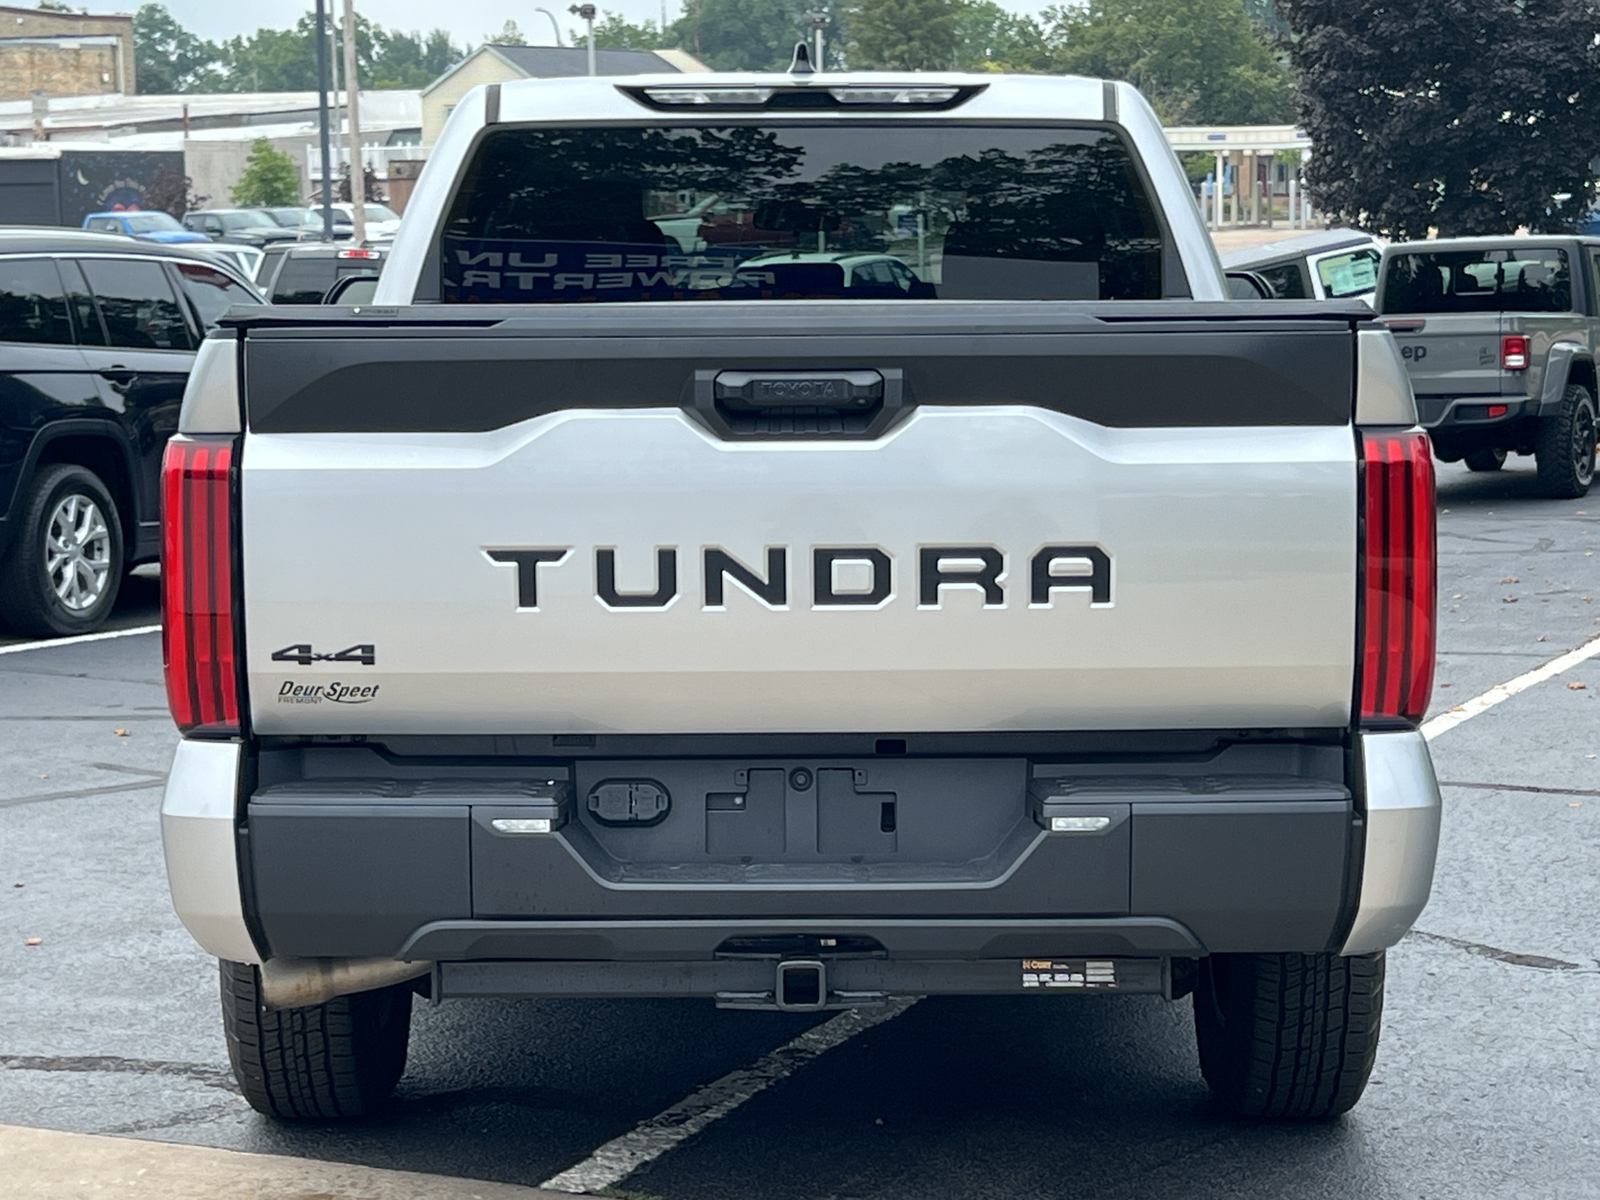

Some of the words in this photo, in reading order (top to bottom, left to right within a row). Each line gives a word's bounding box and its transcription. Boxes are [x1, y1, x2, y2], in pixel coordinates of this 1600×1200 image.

[1401, 345, 1427, 361] ep
[760, 381, 838, 398] TOYOTA
[480, 543, 1116, 612] TUNDRA
[271, 644, 375, 665] 4x4
[277, 696, 322, 704] FREMONT
[279, 680, 324, 696] Deur
[326, 681, 380, 702] Speet
